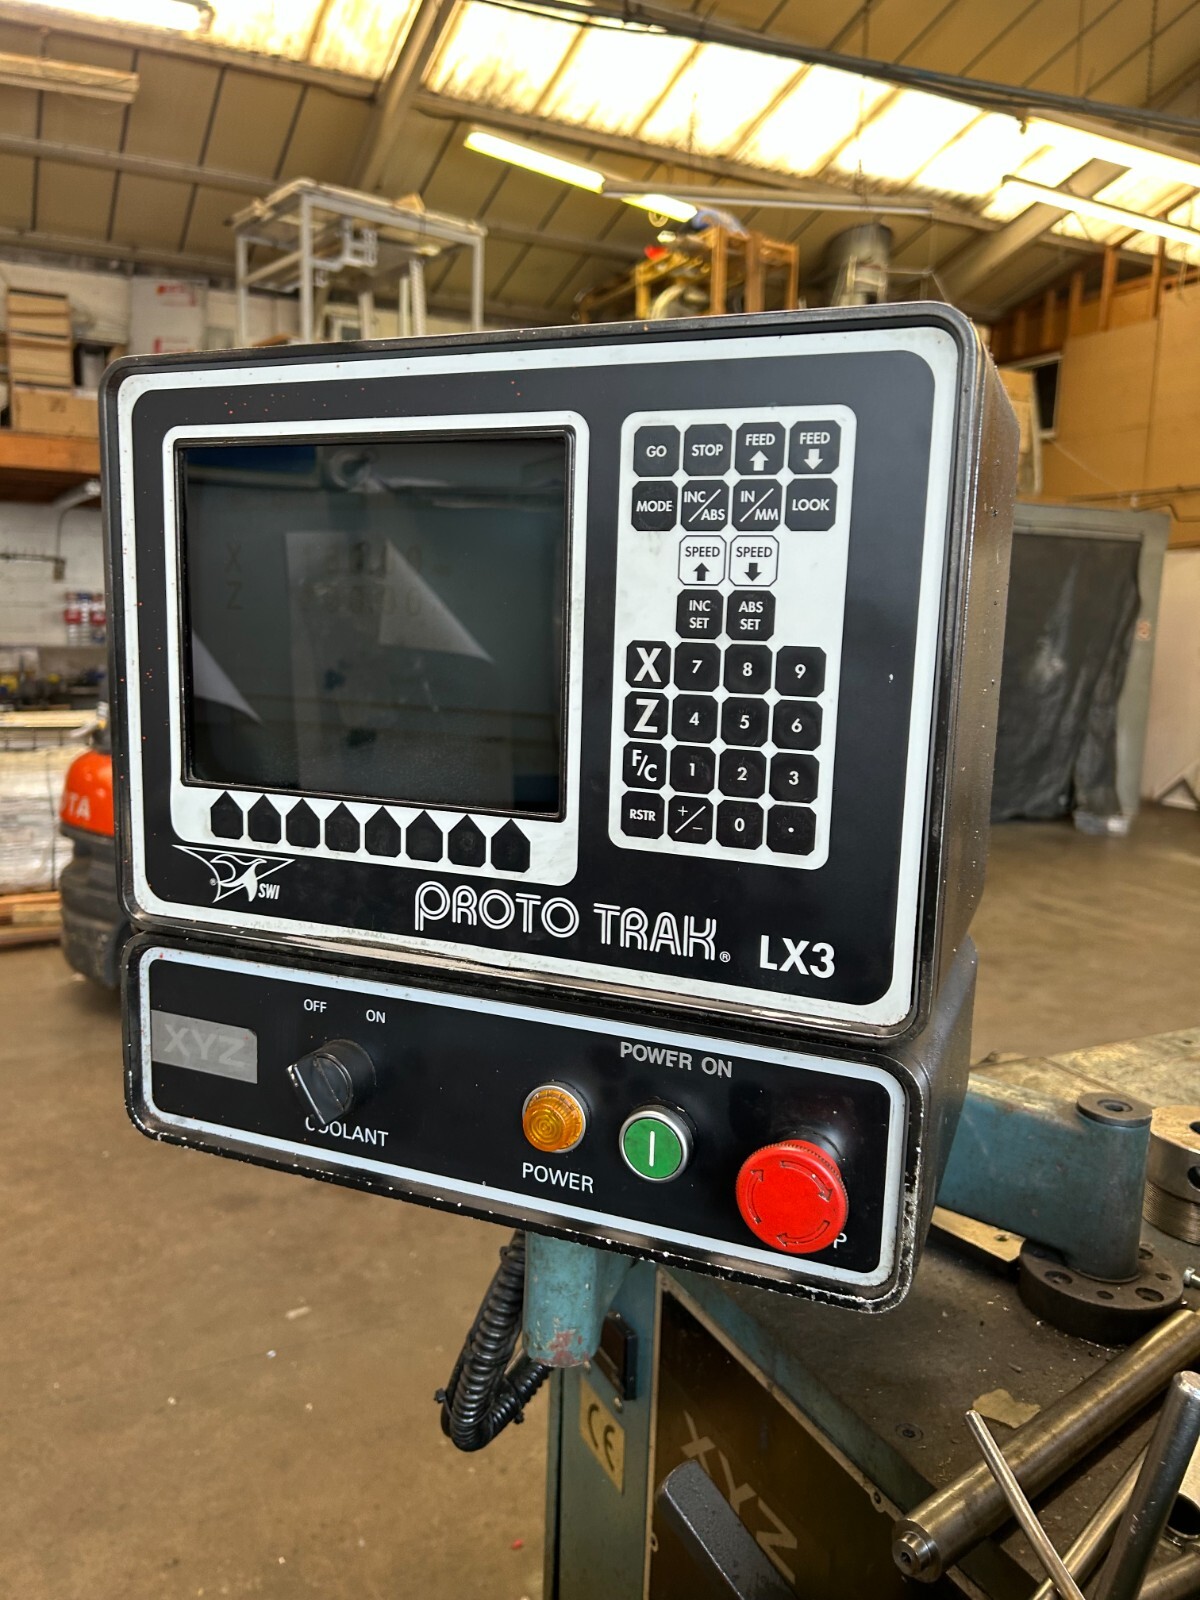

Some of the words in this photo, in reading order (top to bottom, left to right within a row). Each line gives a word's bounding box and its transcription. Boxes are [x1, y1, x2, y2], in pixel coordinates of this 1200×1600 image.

[745, 434, 776, 446] FEED
[800, 432, 830, 445] FEED
[646, 446, 667, 458] GO
[691, 444, 724, 457] STOP
[636, 500, 673, 513] MODE
[792, 499, 830, 512] LOOK
[685, 546, 720, 558] SPEED
[736, 546, 773, 558] SPEED
[689, 600, 711, 612] INC
[738, 602, 764, 614] ABS
[689, 617, 709, 629] SET
[740, 618, 761, 630] SET
[633, 647, 662, 683] X
[692, 660, 702, 674] 7
[742, 662, 753, 677] 8
[794, 664, 806, 679] 9
[633, 698, 660, 734] Z
[689, 711, 700, 726] 4
[739, 714, 750, 729] 5
[791, 718, 802, 733] 6
[689, 762, 696, 777] 1
[737, 766, 748, 782] 2
[788, 770, 800, 786] 3
[629, 809, 656, 822] RSTR
[734, 818, 746, 832] 0
[258, 882, 280, 900] SWI
[414, 880, 580, 938] PROTO
[759, 934, 836, 980] LX3
[304, 998, 327, 1014] OFF
[366, 1009, 386, 1024] ON
[163, 1022, 247, 1068] XYZ
[620, 1041, 692, 1071] POWER
[702, 1056, 733, 1078] ON
[522, 1162, 594, 1194] POWER
